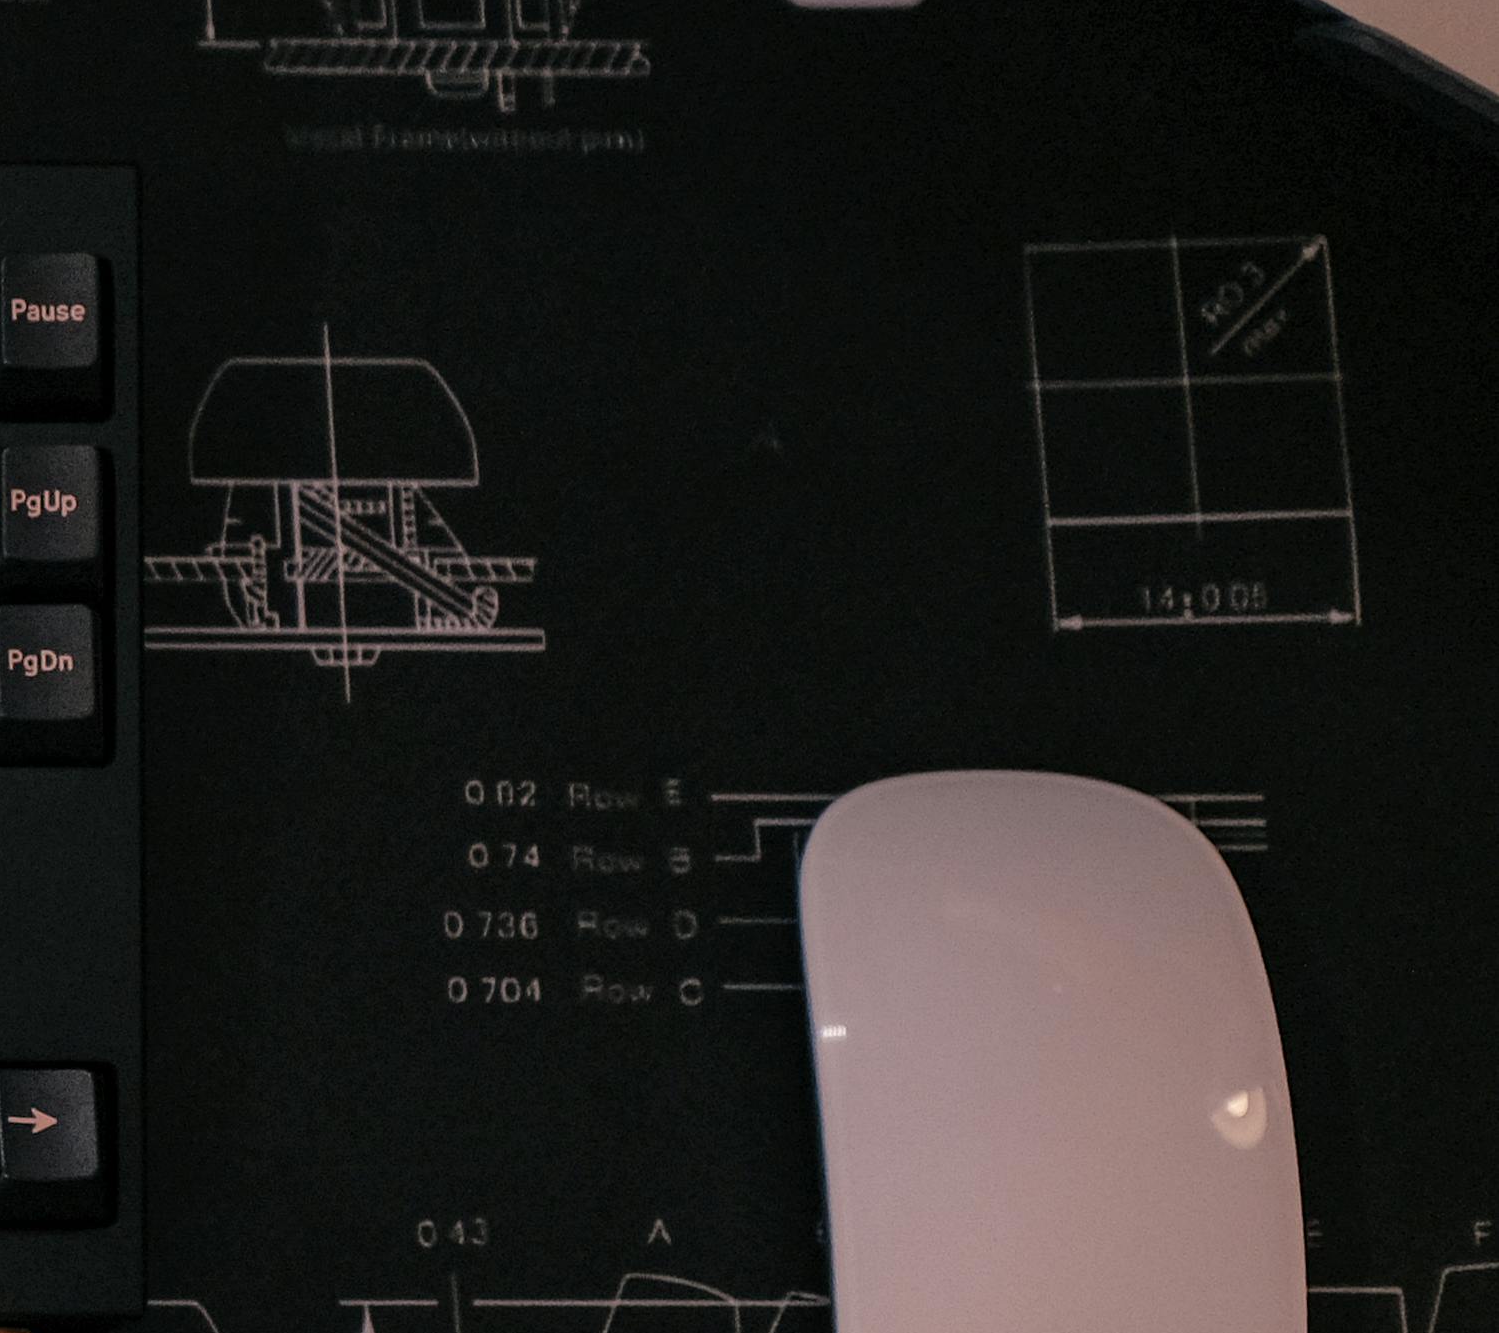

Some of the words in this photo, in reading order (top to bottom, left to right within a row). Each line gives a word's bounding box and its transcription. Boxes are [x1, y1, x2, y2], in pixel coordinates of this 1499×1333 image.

[11, 298, 86, 322] Pause
[11, 489, 77, 518] PgUp
[8, 648, 74, 677] PgDn
